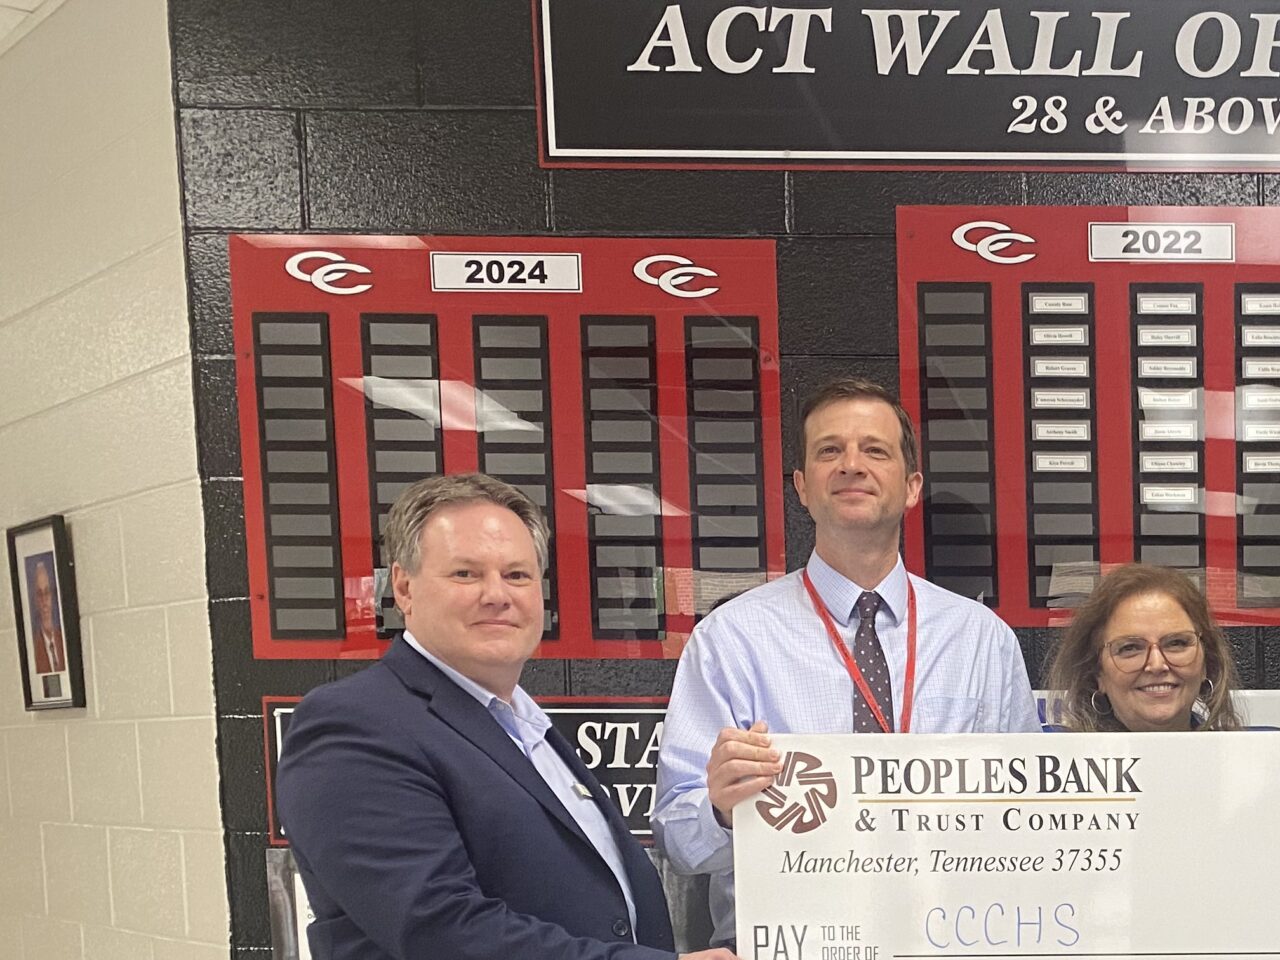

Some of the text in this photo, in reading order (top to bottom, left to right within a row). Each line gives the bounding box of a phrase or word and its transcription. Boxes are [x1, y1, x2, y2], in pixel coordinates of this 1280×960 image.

[627, 4, 834, 76] ACT
[862, 9, 1148, 79] WALL
[1007, 95, 1068, 135] 28
[1084, 97, 1129, 135] &
[1121, 230, 1203, 255] 2022
[465, 259, 548, 284] 2024
[851, 755, 1143, 797] PEOPLES BANK
[854, 807, 1141, 832] & TRUST COMPANY
[779, 848, 1123, 877] Manchester, Tennessee 37355
[820, 926, 836, 942] TO
[840, 925, 862, 942] THE
[925, 902, 1082, 949] CCCHS
